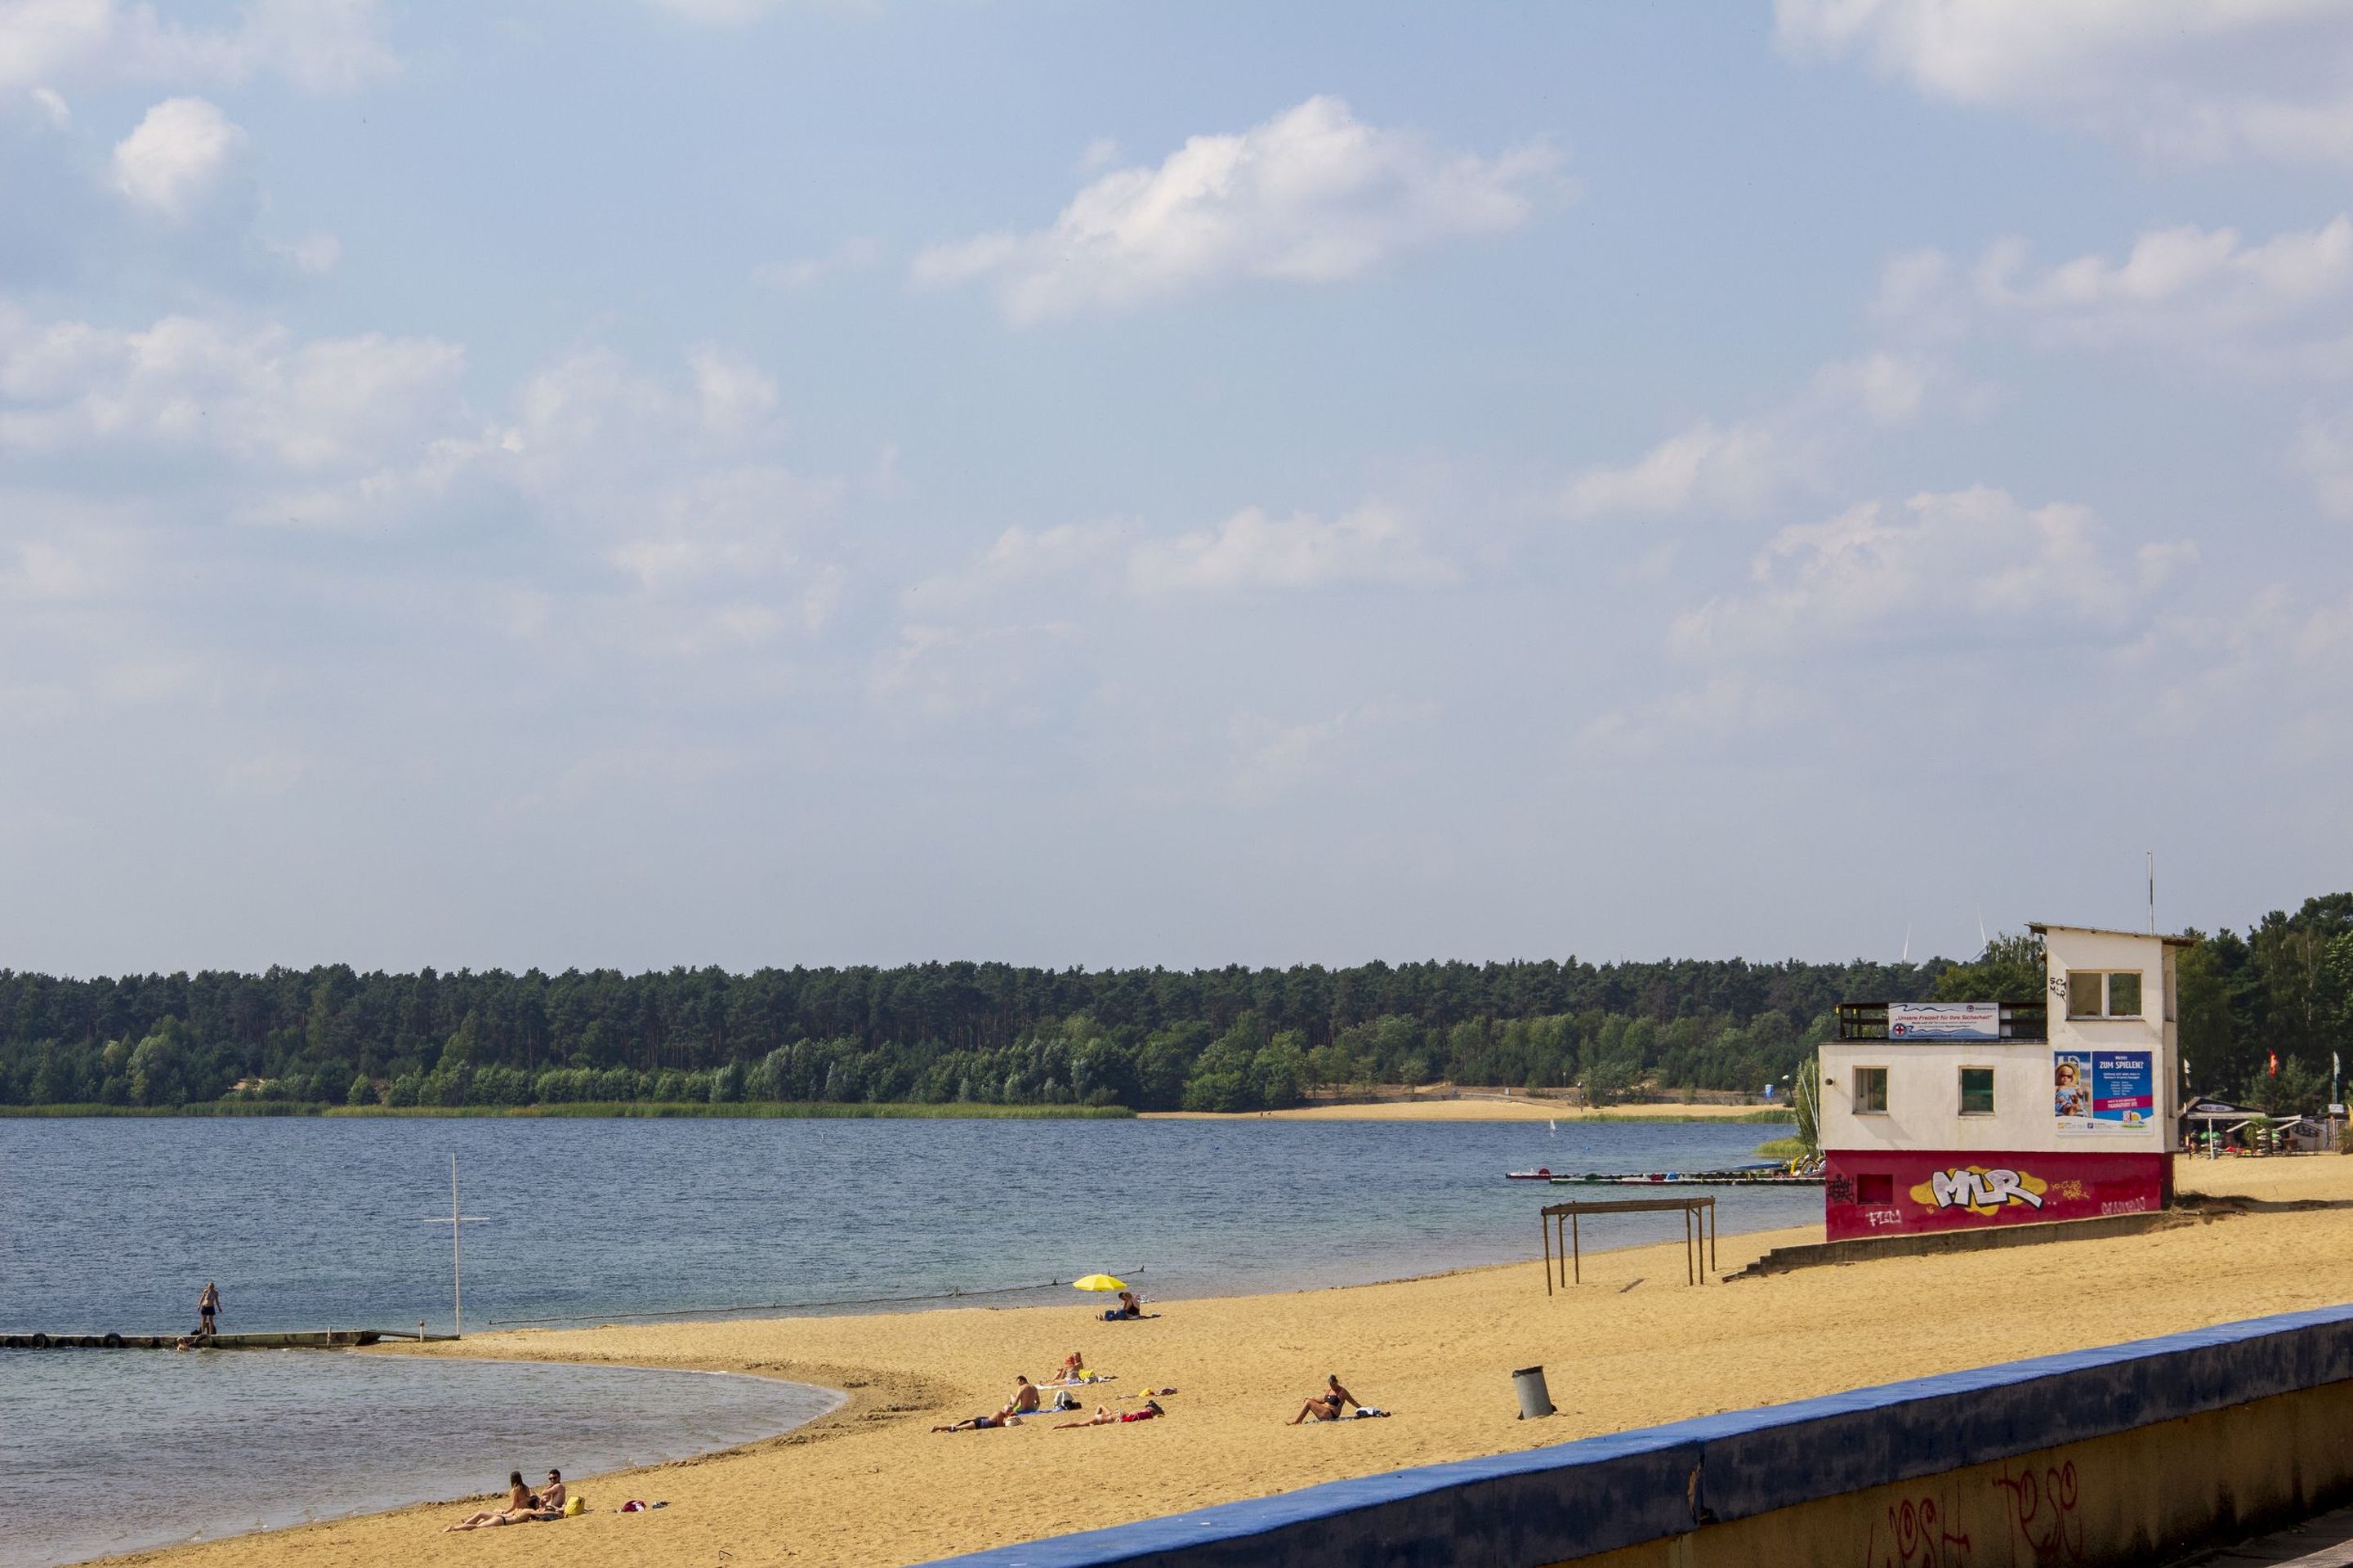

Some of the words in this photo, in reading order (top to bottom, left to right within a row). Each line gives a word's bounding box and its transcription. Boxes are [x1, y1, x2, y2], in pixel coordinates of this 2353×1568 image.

[2099, 1061, 2114, 1069] ZUM
[2115, 1061, 2144, 1069] SPIELEN?
[1931, 1168, 2044, 1210] MLR
